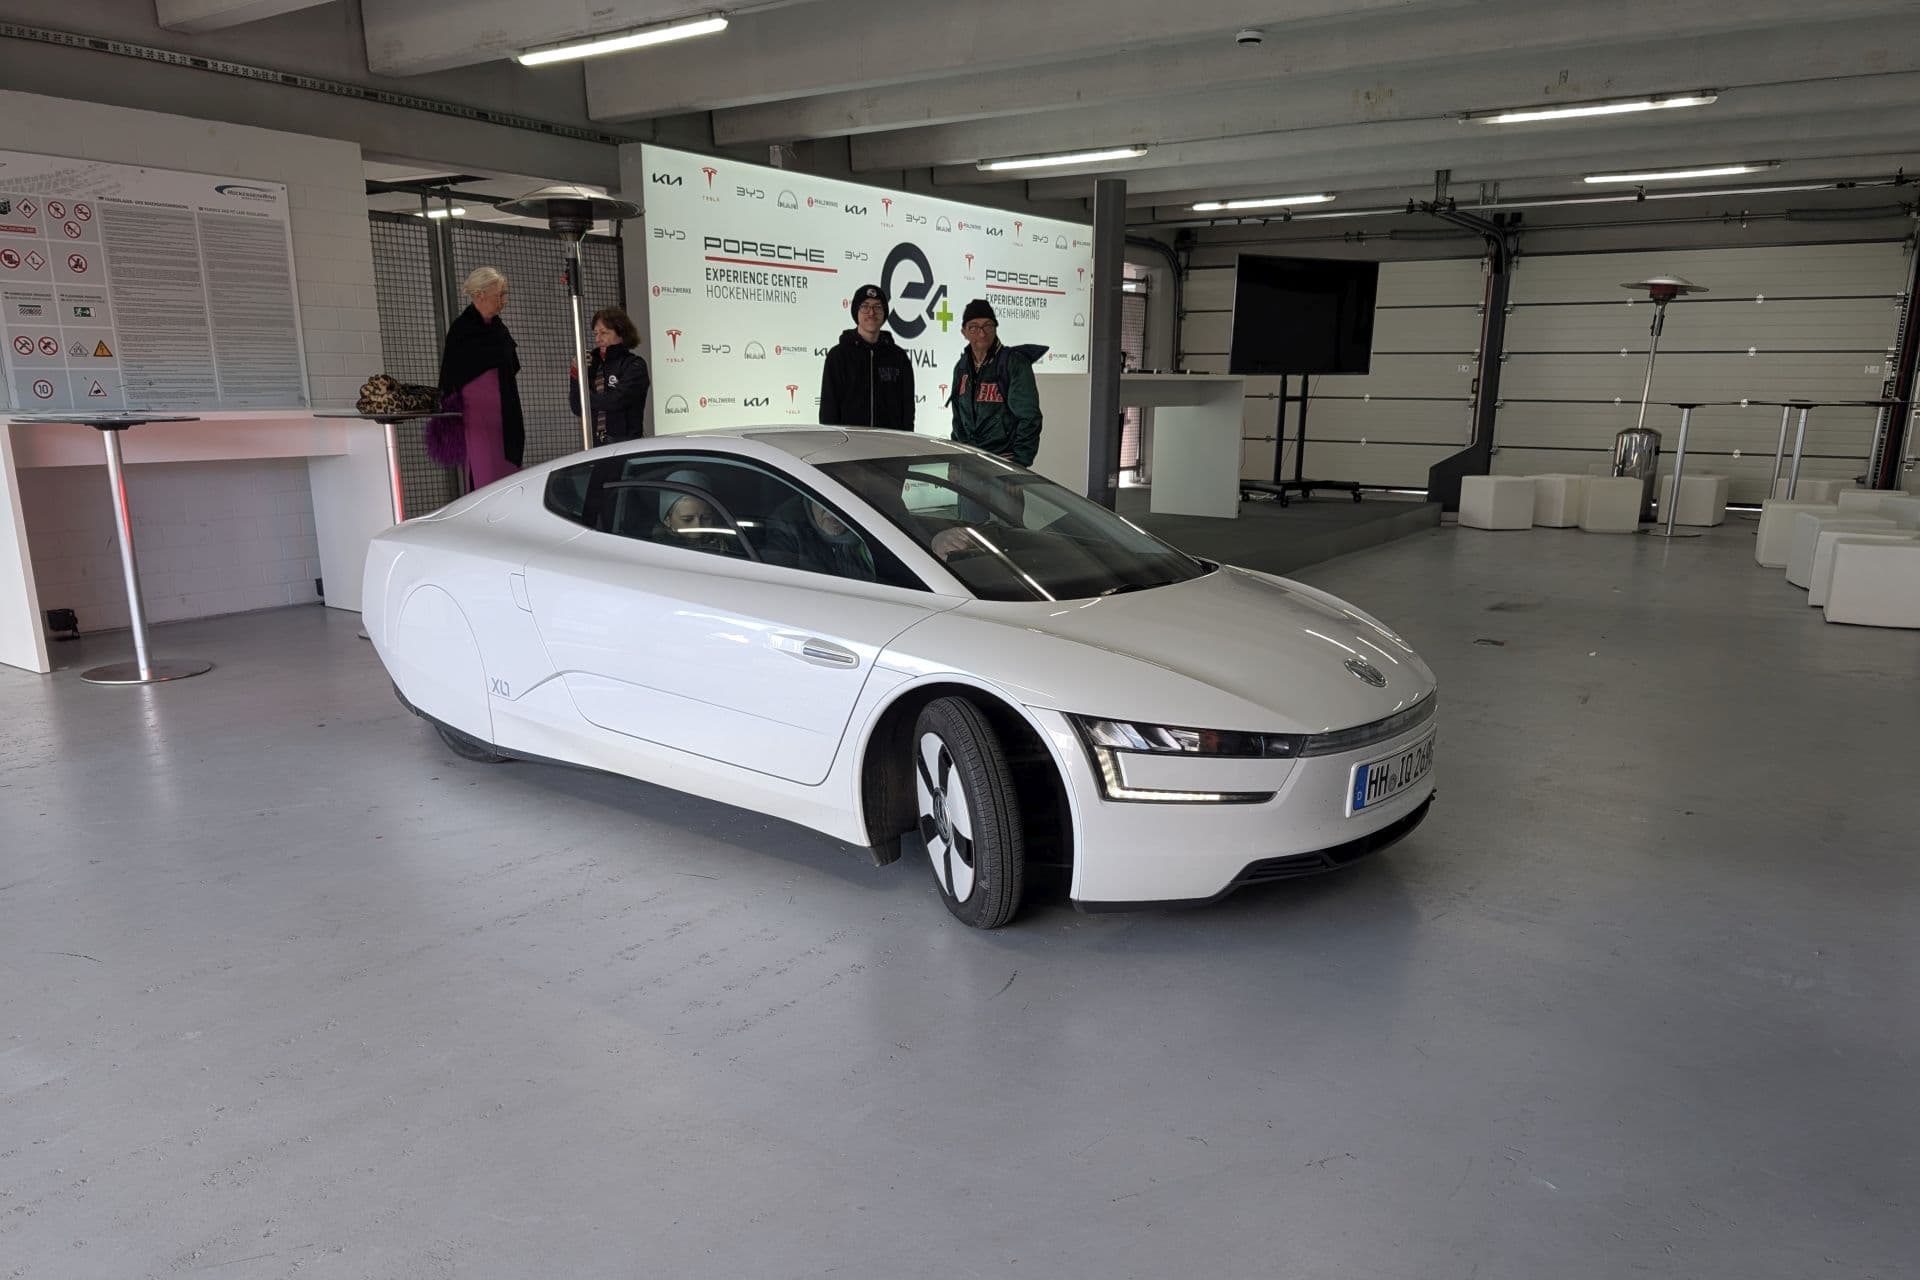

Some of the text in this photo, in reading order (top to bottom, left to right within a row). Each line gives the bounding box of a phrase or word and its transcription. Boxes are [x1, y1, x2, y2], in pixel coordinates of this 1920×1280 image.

[736, 186, 765, 199] BYD
[906, 213, 927, 225] BYD
[653, 227, 686, 240] BYD
[1032, 234, 1049, 244] BYD
[704, 236, 825, 263] PORSCHE
[844, 250, 869, 261] BYD
[705, 267, 808, 289] EXPERIENCE CENTER
[985, 269, 1058, 288] PORSCHE
[706, 284, 797, 304] HOCKENHEIMRING
[985, 293, 1048, 308] EXPERIENCE CENTER
[993, 306, 1041, 320] CKENHEIMRING
[701, 343, 732, 354] BYD
[38, 384, 48, 394] 10
[1366, 763, 1390, 801] HH
